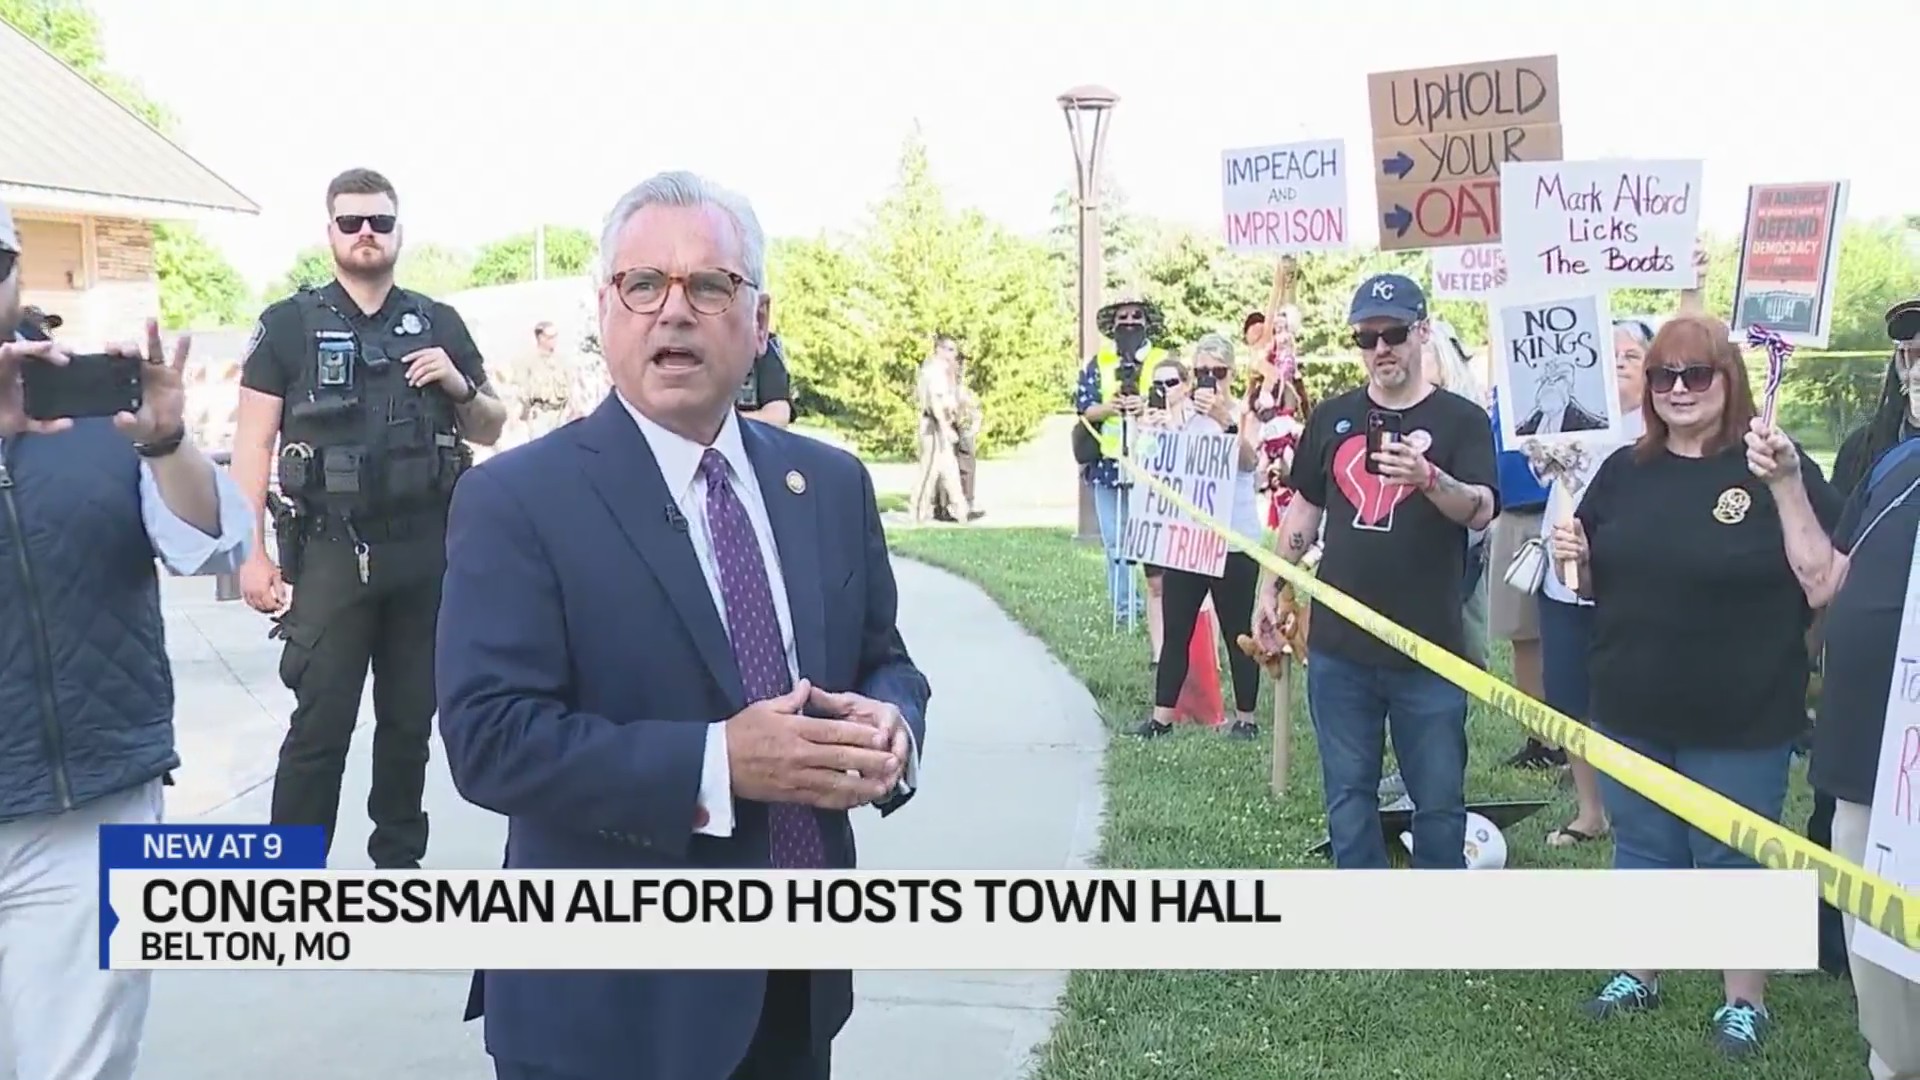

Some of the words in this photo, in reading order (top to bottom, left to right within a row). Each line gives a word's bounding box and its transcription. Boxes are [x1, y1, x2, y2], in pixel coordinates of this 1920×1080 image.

[1226, 148, 1338, 186] IMPEACH
[1419, 127, 1527, 182] YOUR
[1267, 187, 1297, 204] AND
[1415, 181, 1502, 238] OAT
[1535, 172, 1603, 213] Mark
[1613, 174, 1691, 216] Alford
[1227, 208, 1344, 246] IMPRISON
[1569, 216, 1639, 243] Licks
[1757, 214, 1819, 240] DEFEND
[1538, 245, 1590, 275] The
[1600, 246, 1675, 274] Boots
[1752, 239, 1820, 256] DEMOCRACY
[1371, 280, 1395, 301] KC
[1523, 306, 1577, 337] NO
[1511, 331, 1598, 369] KINGS
[1185, 434, 1236, 480] WORK
[1193, 479, 1217, 517] US
[1122, 518, 1163, 562] NOT
[1166, 524, 1227, 574] TRUMP
